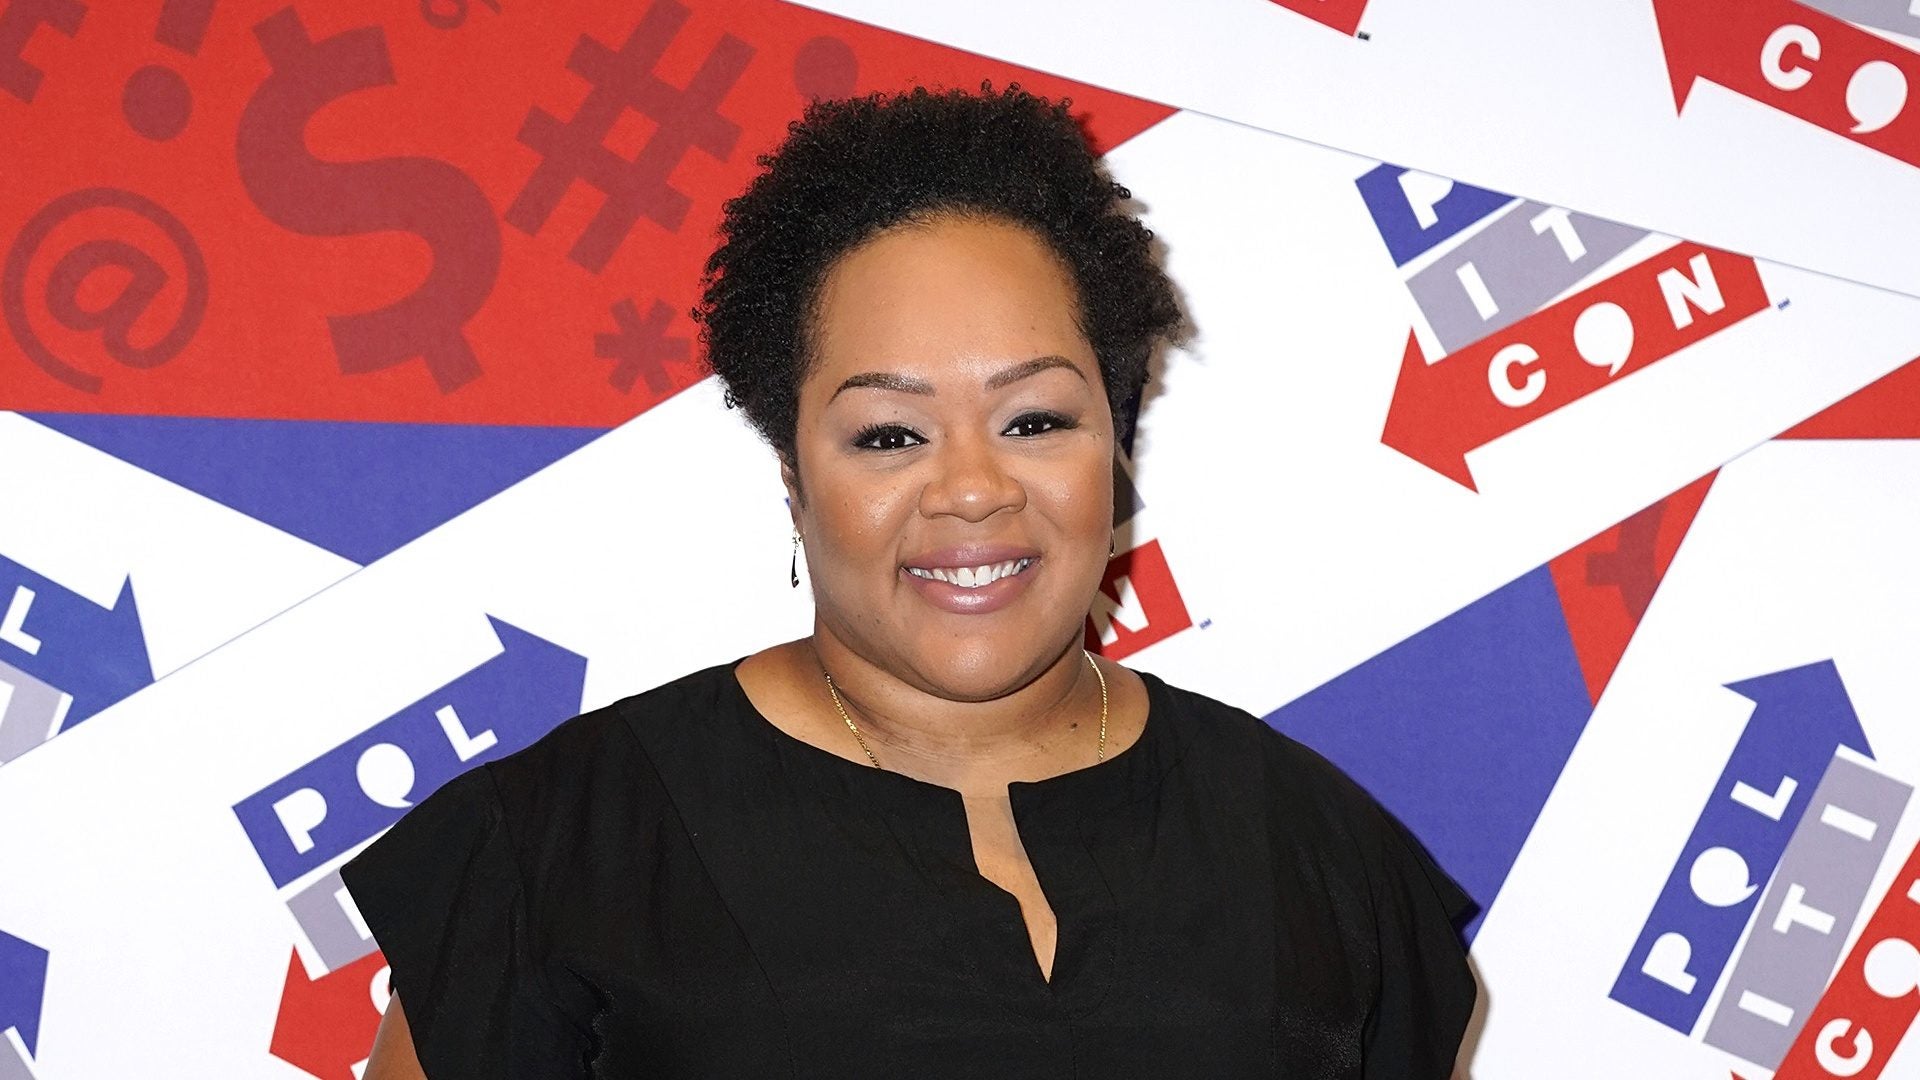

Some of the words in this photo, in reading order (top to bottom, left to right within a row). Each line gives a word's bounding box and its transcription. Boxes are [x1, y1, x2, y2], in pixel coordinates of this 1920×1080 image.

[1488, 252, 1725, 408] CON
[272, 704, 498, 854] POL
[1641, 775, 1798, 995] POL
[1738, 803, 1877, 1027] ITI
[1815, 878, 1920, 1077] CO
